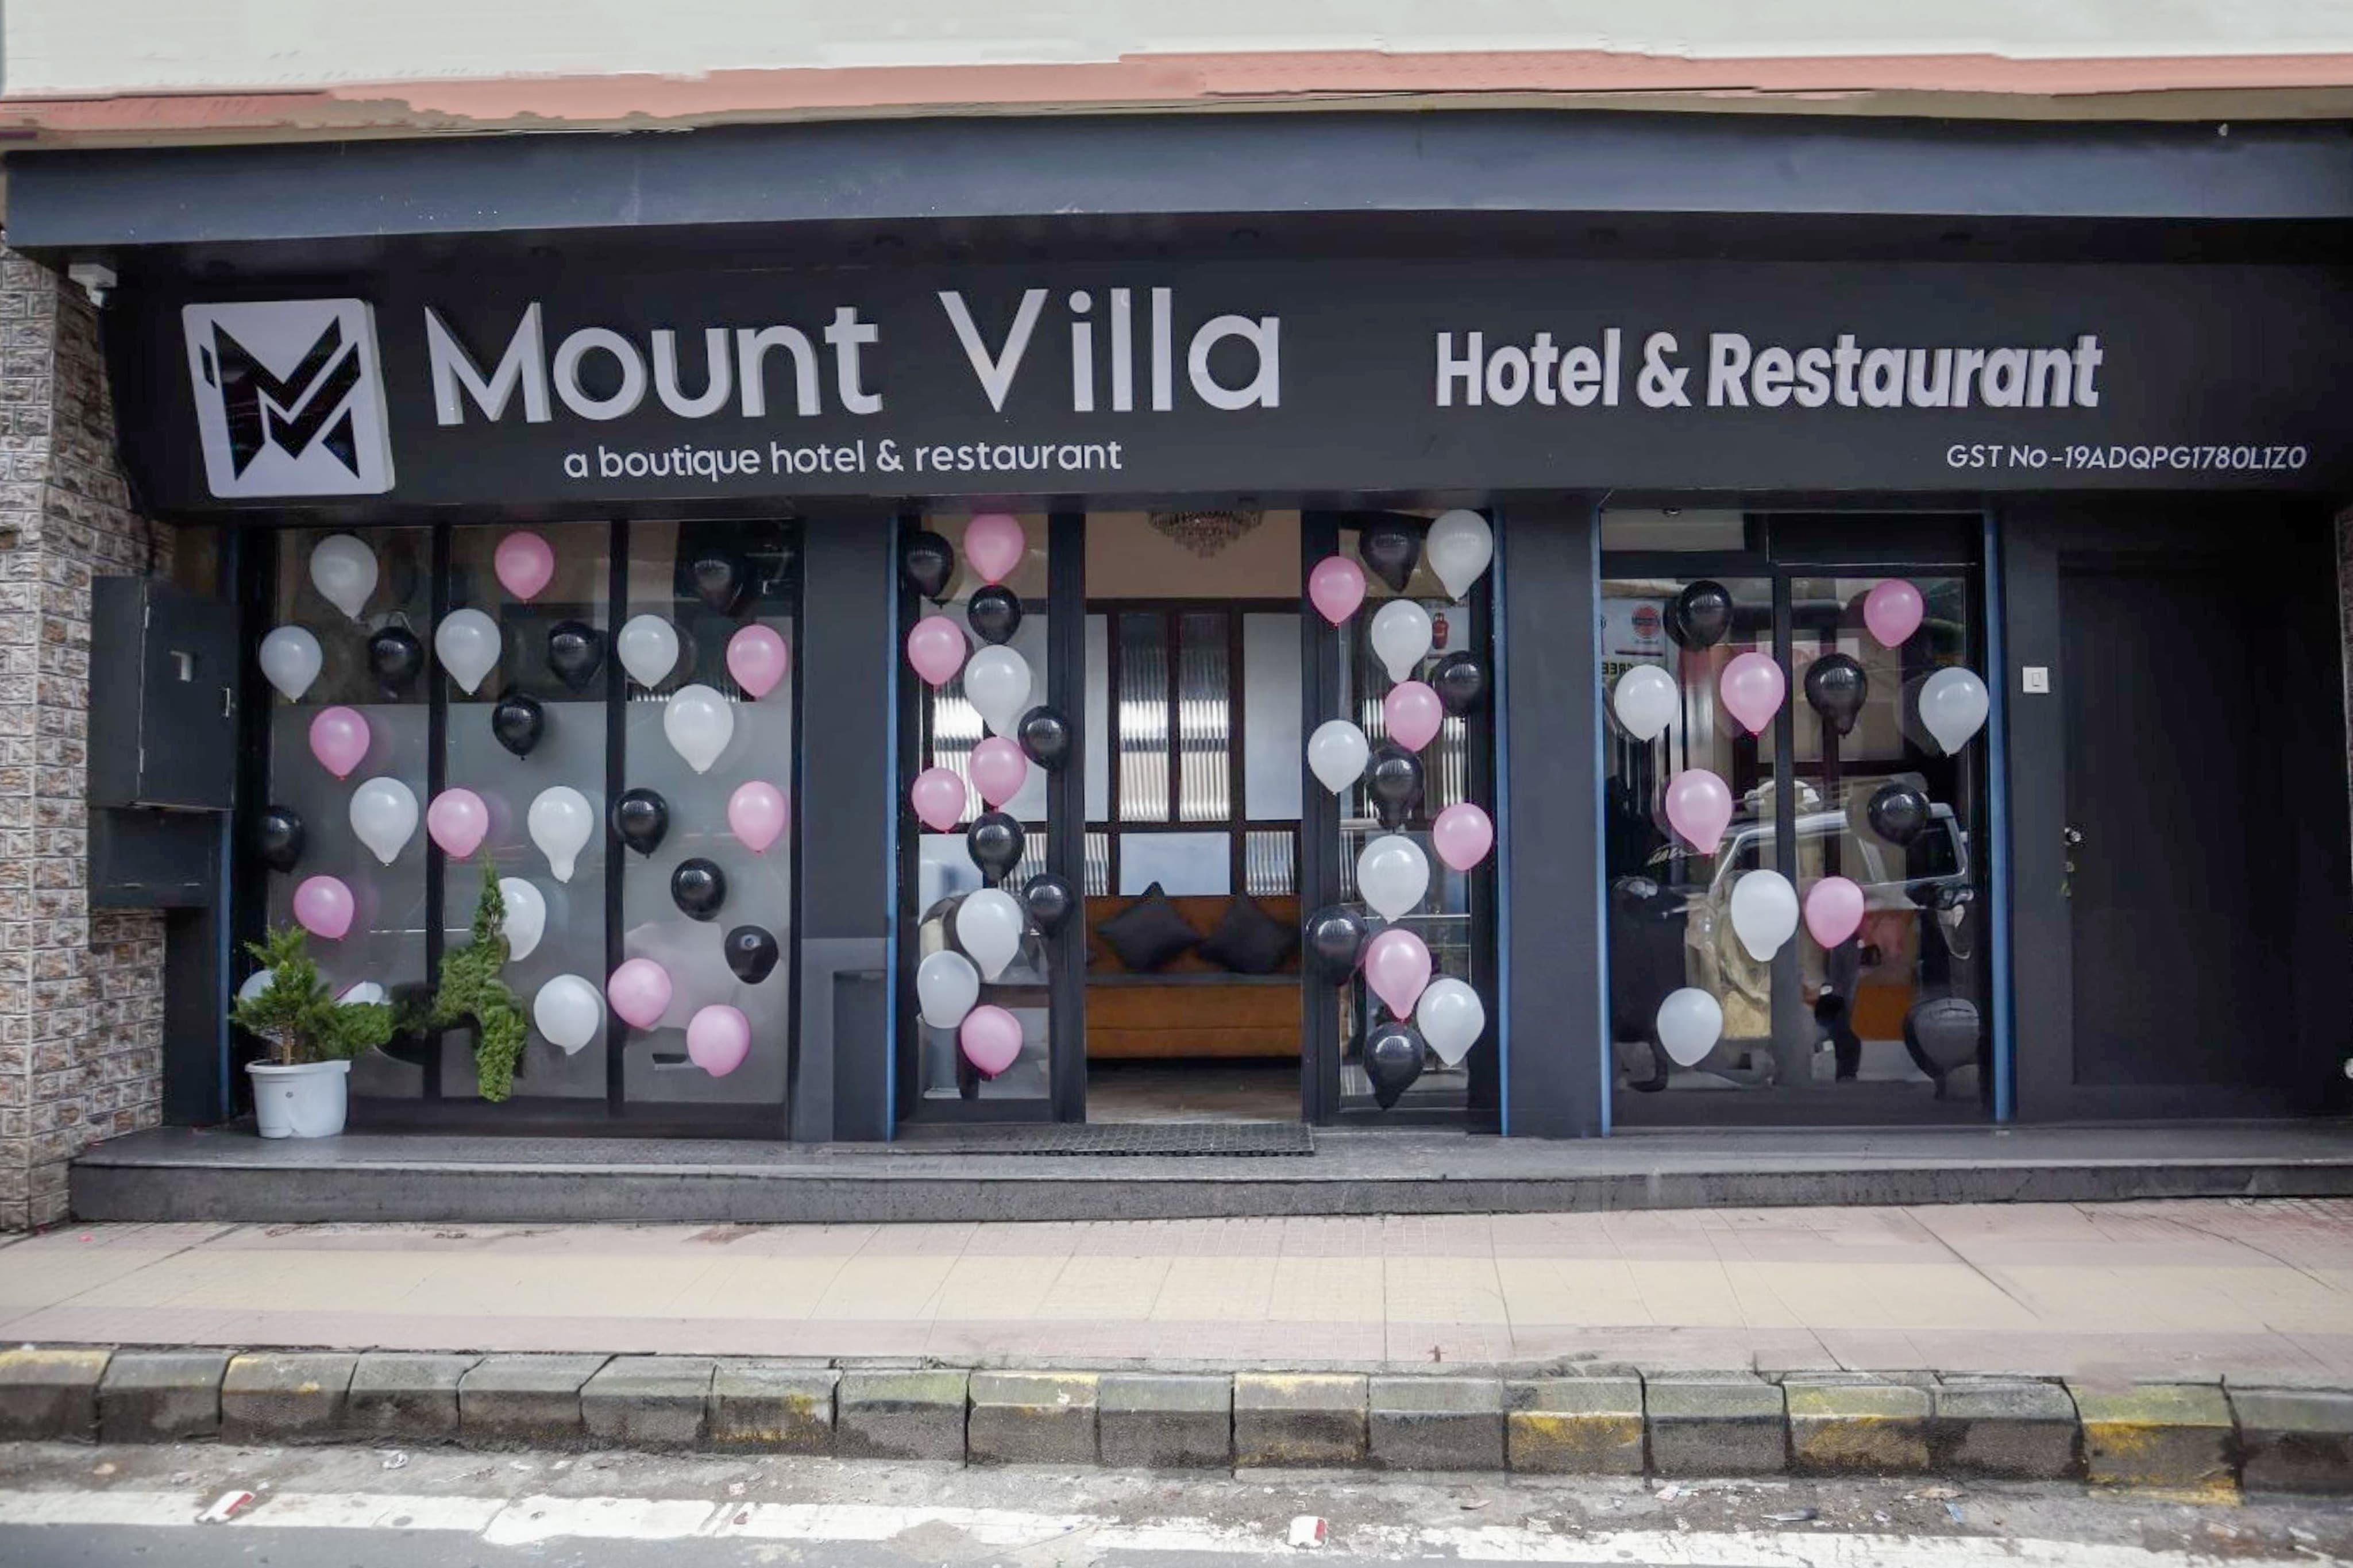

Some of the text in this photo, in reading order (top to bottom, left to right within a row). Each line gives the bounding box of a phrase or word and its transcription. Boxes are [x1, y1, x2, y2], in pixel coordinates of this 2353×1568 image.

[424, 287, 1280, 426] Mount Villa
[1436, 327, 2104, 408] Hotel & Restaurant
[564, 438, 1123, 482] a boutique hotel & restaurant
[1946, 444, 2004, 469] GST
